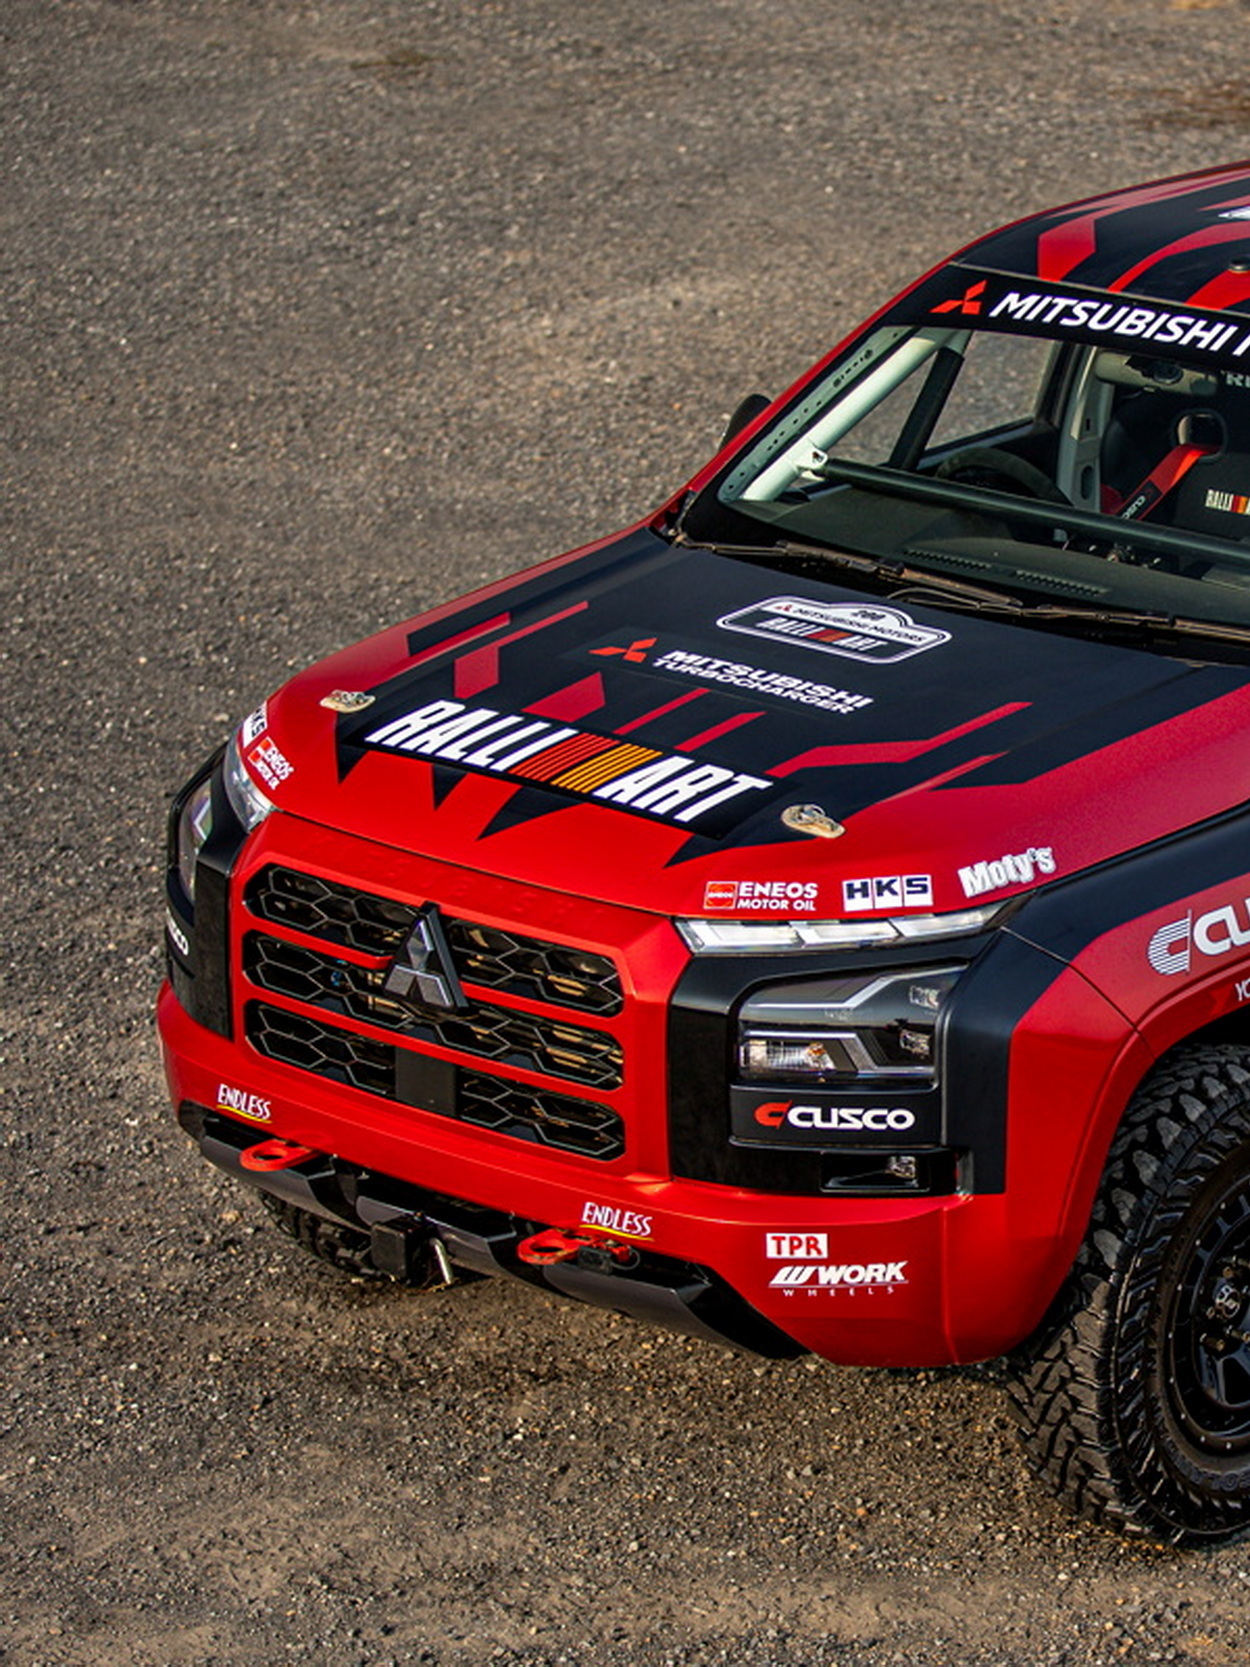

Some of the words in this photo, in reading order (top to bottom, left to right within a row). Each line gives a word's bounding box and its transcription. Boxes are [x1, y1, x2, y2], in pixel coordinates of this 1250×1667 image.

[989, 292, 1229, 351] MITSUBISHI
[652, 658, 855, 715] TURBOCHARGER
[663, 650, 873, 708] MITSUBISHI
[957, 847, 1057, 898] Moty's
[738, 881, 818, 899] ENEOS
[845, 876, 930, 900] HKS
[737, 898, 789, 910] MOTOR
[792, 900, 817, 911] OIL
[217, 1083, 271, 1120] ENDLESS
[788, 1106, 915, 1130] CUSCO
[581, 1201, 653, 1236] ENDLESS
[771, 1236, 823, 1256] TPR
[815, 1261, 908, 1284] WORK
[783, 1286, 894, 1297] WHEELS
